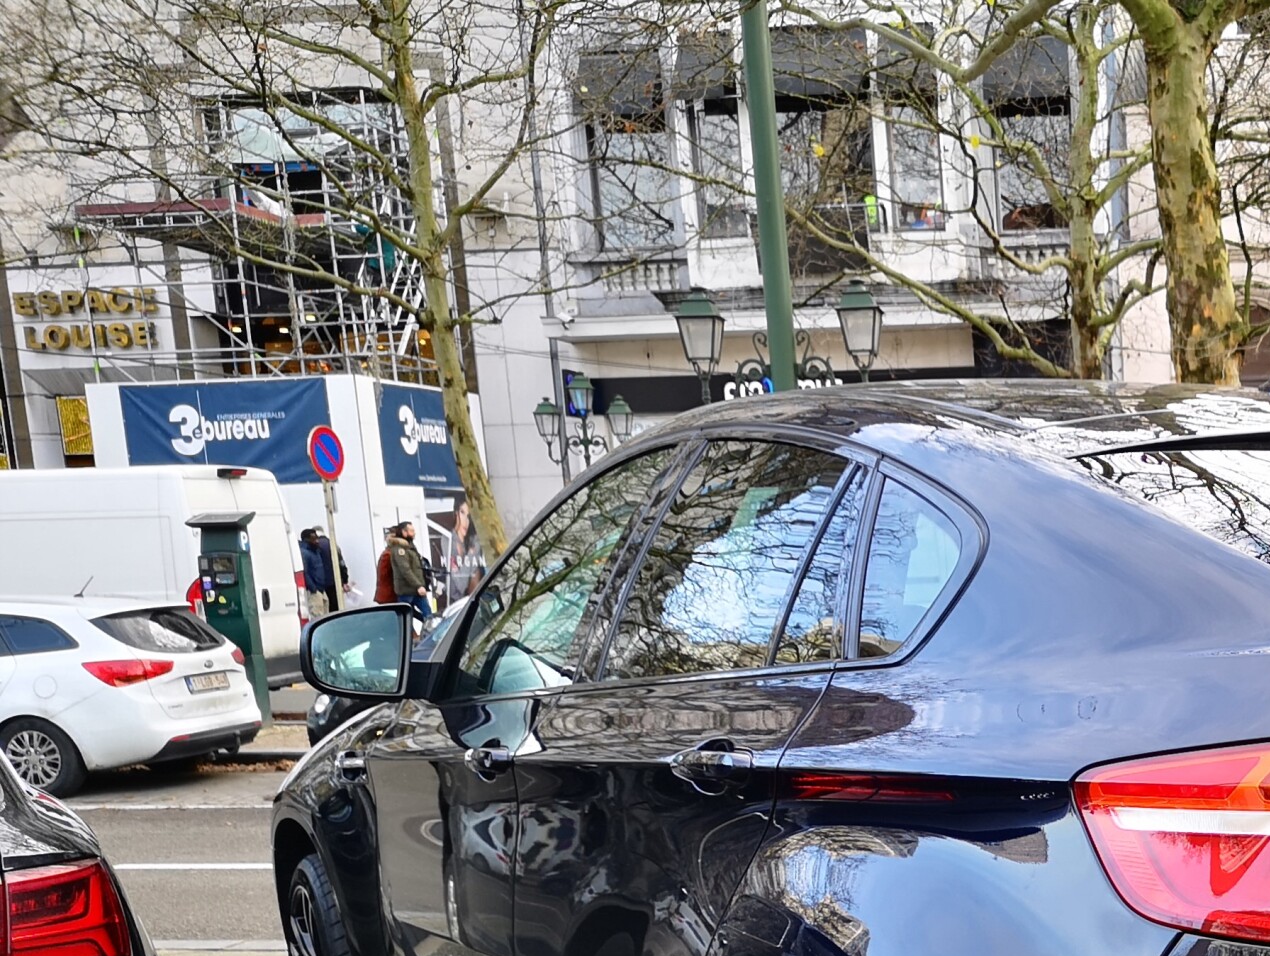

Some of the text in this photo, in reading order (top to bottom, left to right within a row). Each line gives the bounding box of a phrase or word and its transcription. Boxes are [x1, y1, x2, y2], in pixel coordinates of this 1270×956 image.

[12, 287, 159, 316] ESPACE
[23, 322, 158, 351] LOUISE
[201, 415, 270, 441] bureau
[441, 555, 487, 567] MRGAN
